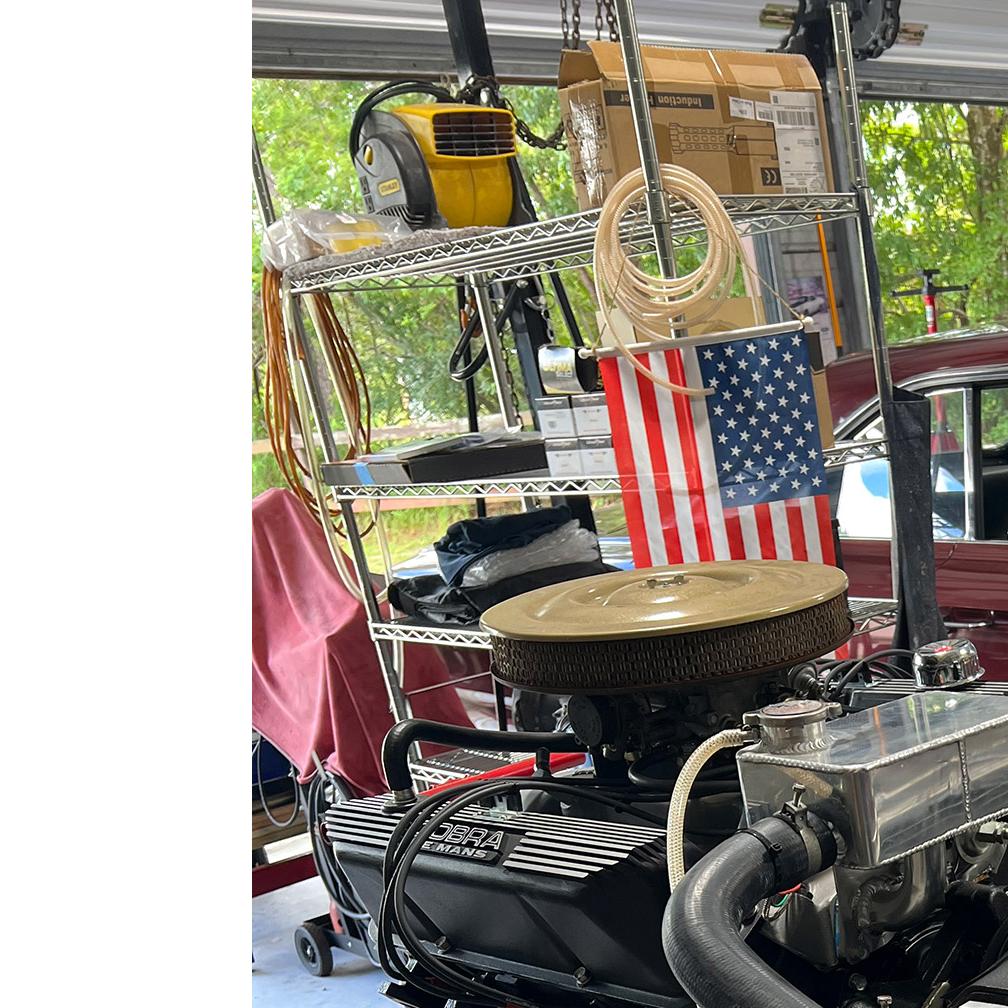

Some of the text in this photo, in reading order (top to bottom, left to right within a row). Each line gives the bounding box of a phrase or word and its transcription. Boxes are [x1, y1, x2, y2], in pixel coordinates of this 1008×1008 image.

[658, 94, 703, 108] Induction
[428, 822, 504, 850] OBRA
[421, 840, 488, 858] E MANS
